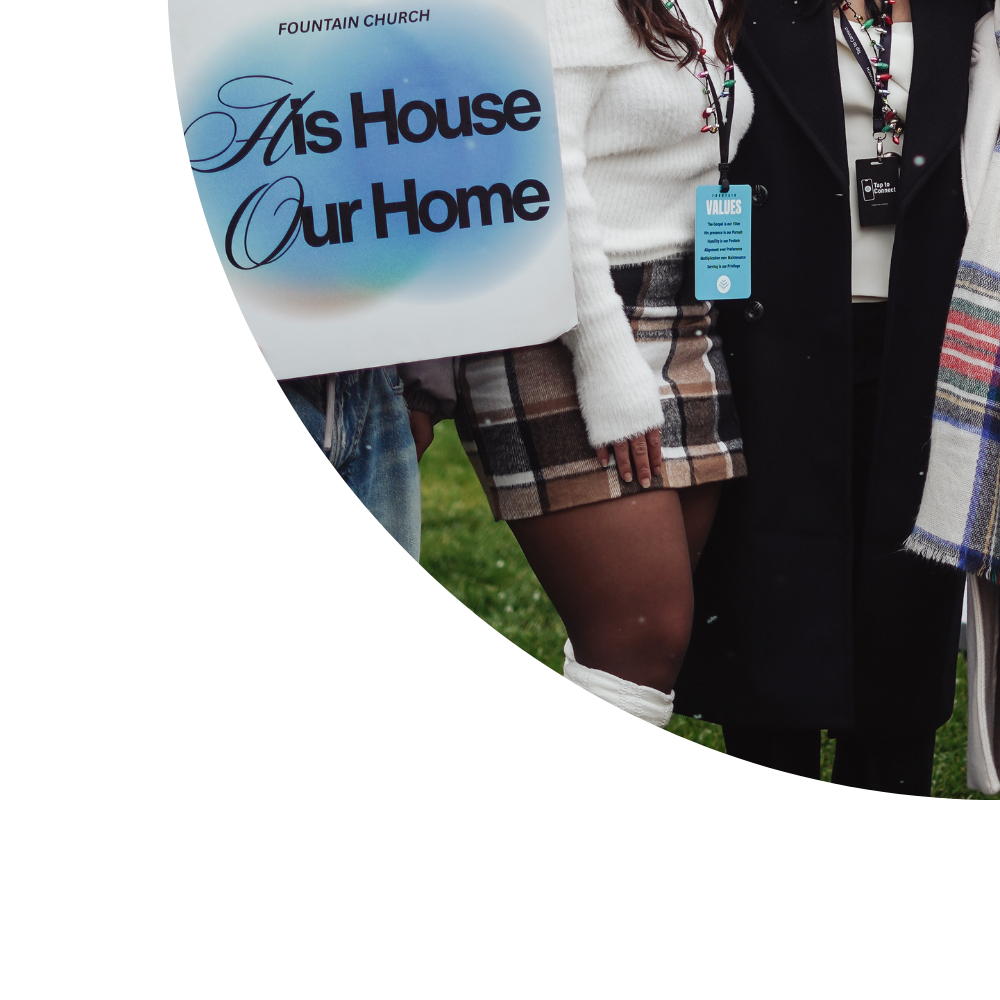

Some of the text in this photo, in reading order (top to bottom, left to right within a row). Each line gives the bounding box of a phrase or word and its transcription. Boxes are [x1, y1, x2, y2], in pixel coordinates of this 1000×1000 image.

[278, 9, 430, 36] FOUNTAIN CHURCH
[184, 75, 542, 173] His House
[225, 176, 550, 270] Our Home
[706, 199, 742, 215] VALUES
